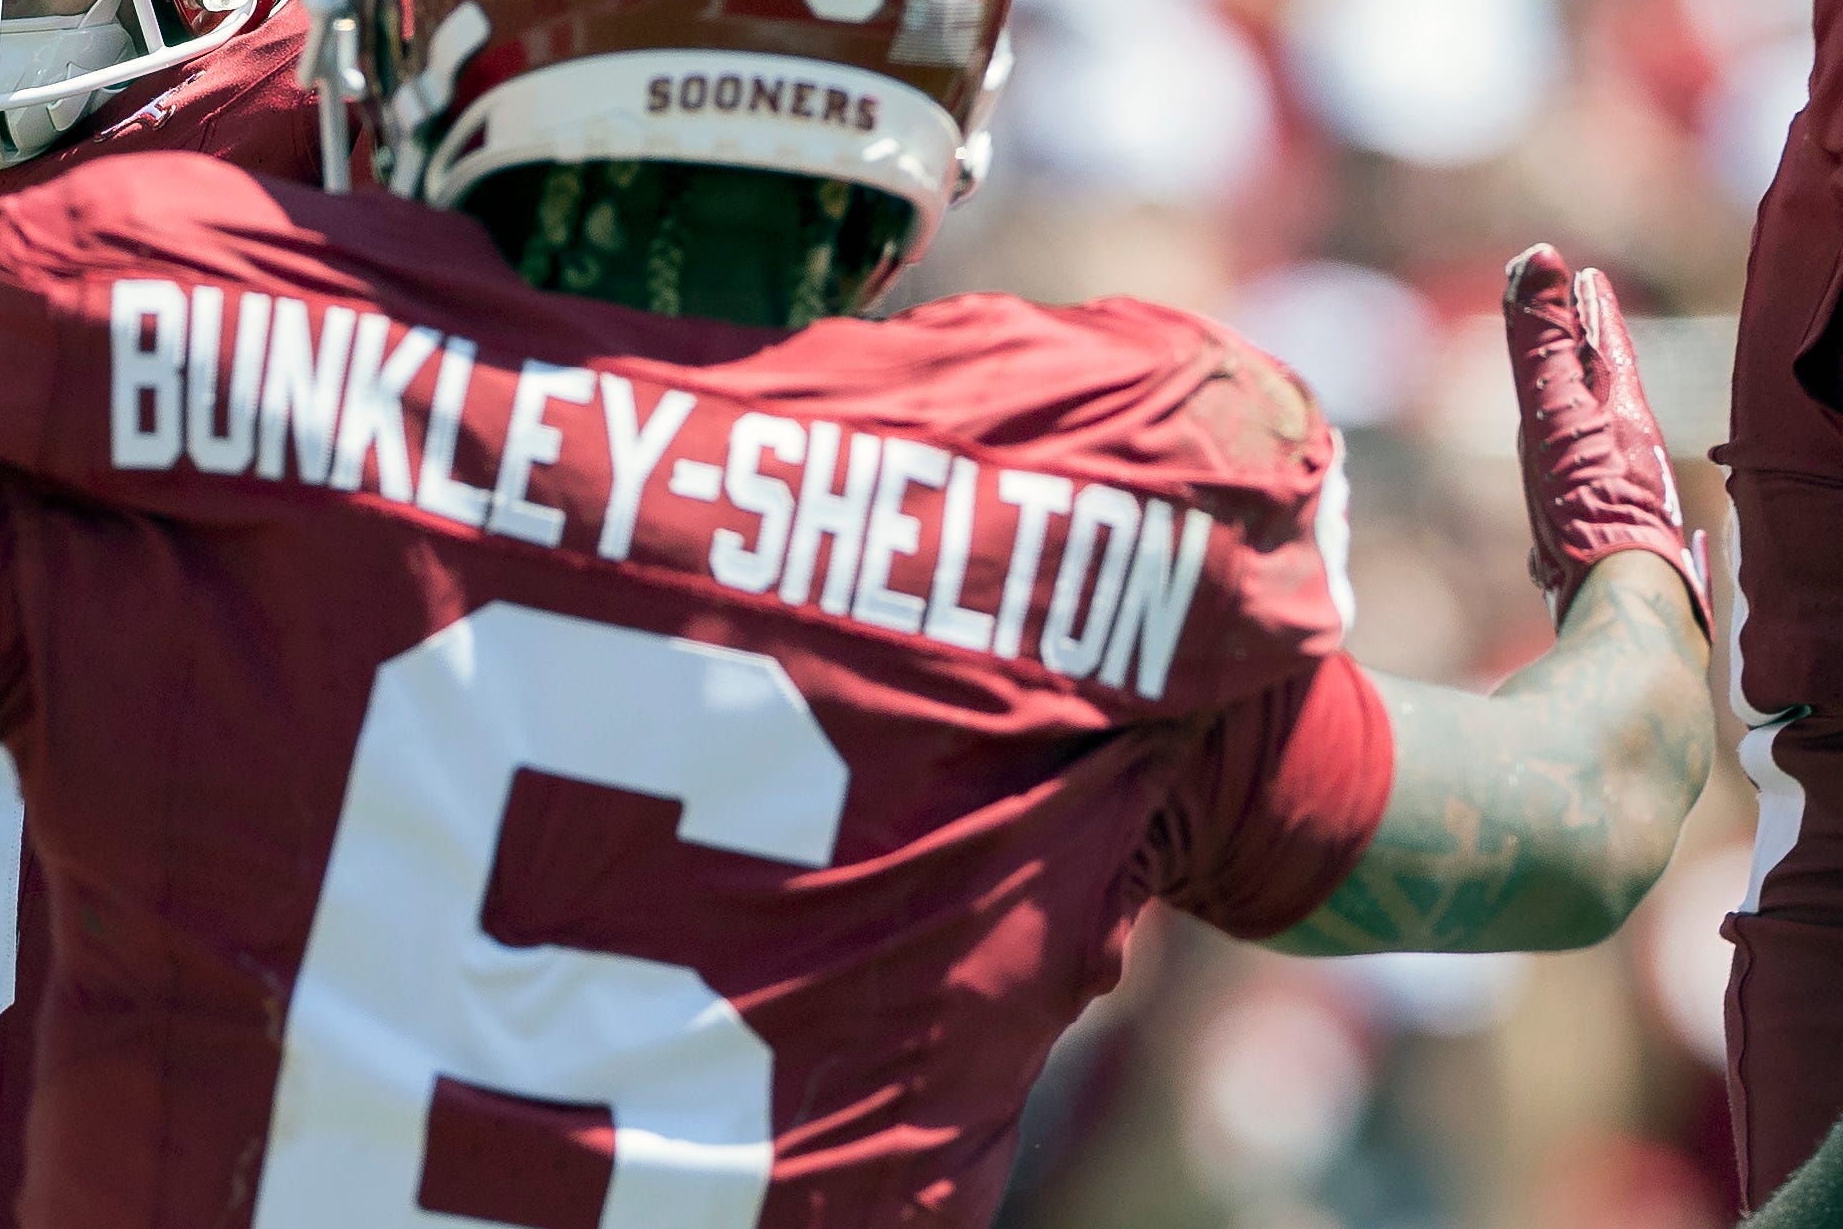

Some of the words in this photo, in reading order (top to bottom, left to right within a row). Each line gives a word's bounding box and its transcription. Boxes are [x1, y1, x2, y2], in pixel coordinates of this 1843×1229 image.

[645, 72, 881, 132] SOONERS
[110, 278, 1214, 699] BUNKLEY-SHELTON
[252, 600, 850, 1229] 6
